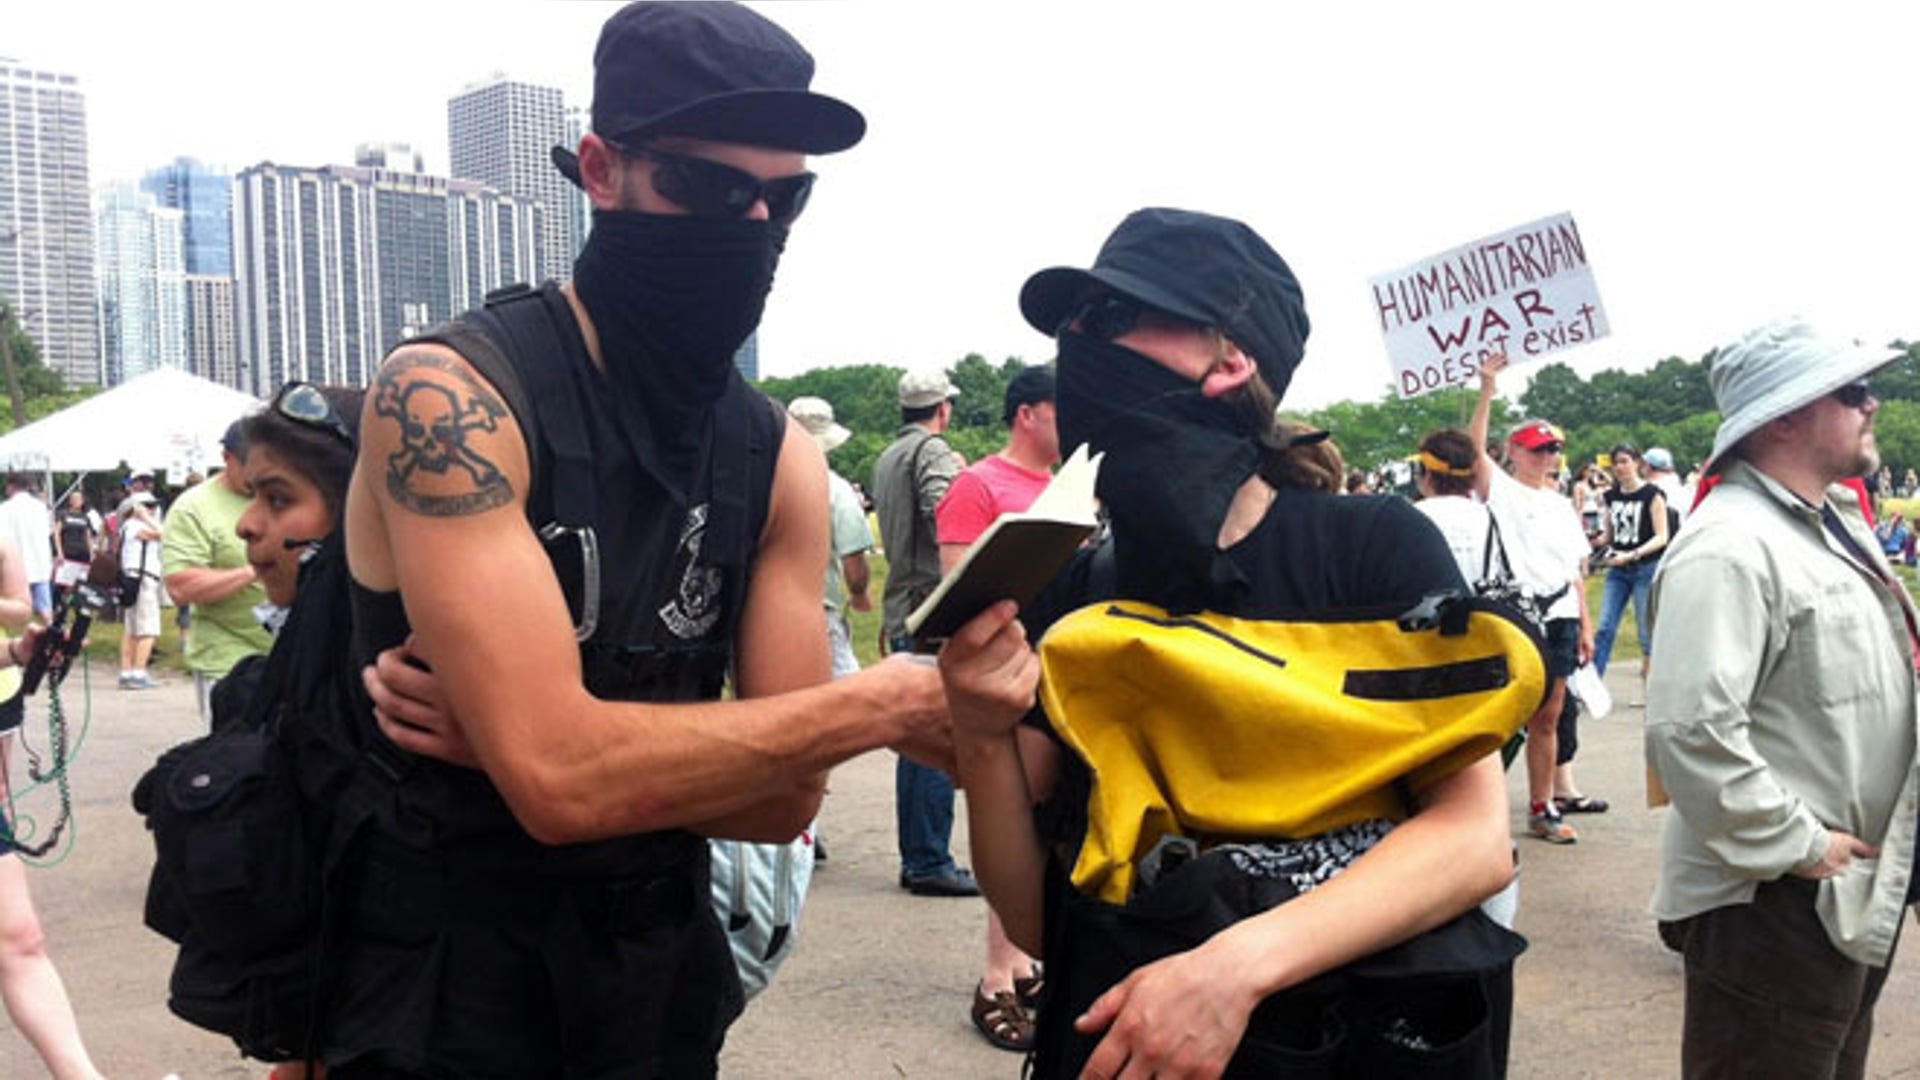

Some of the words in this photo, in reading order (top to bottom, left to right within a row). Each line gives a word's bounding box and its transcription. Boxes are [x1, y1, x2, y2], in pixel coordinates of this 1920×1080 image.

[1373, 217, 1588, 331] HUMANITARIAN
[1428, 289, 1554, 354] WAR
[1523, 302, 1595, 355] exist
